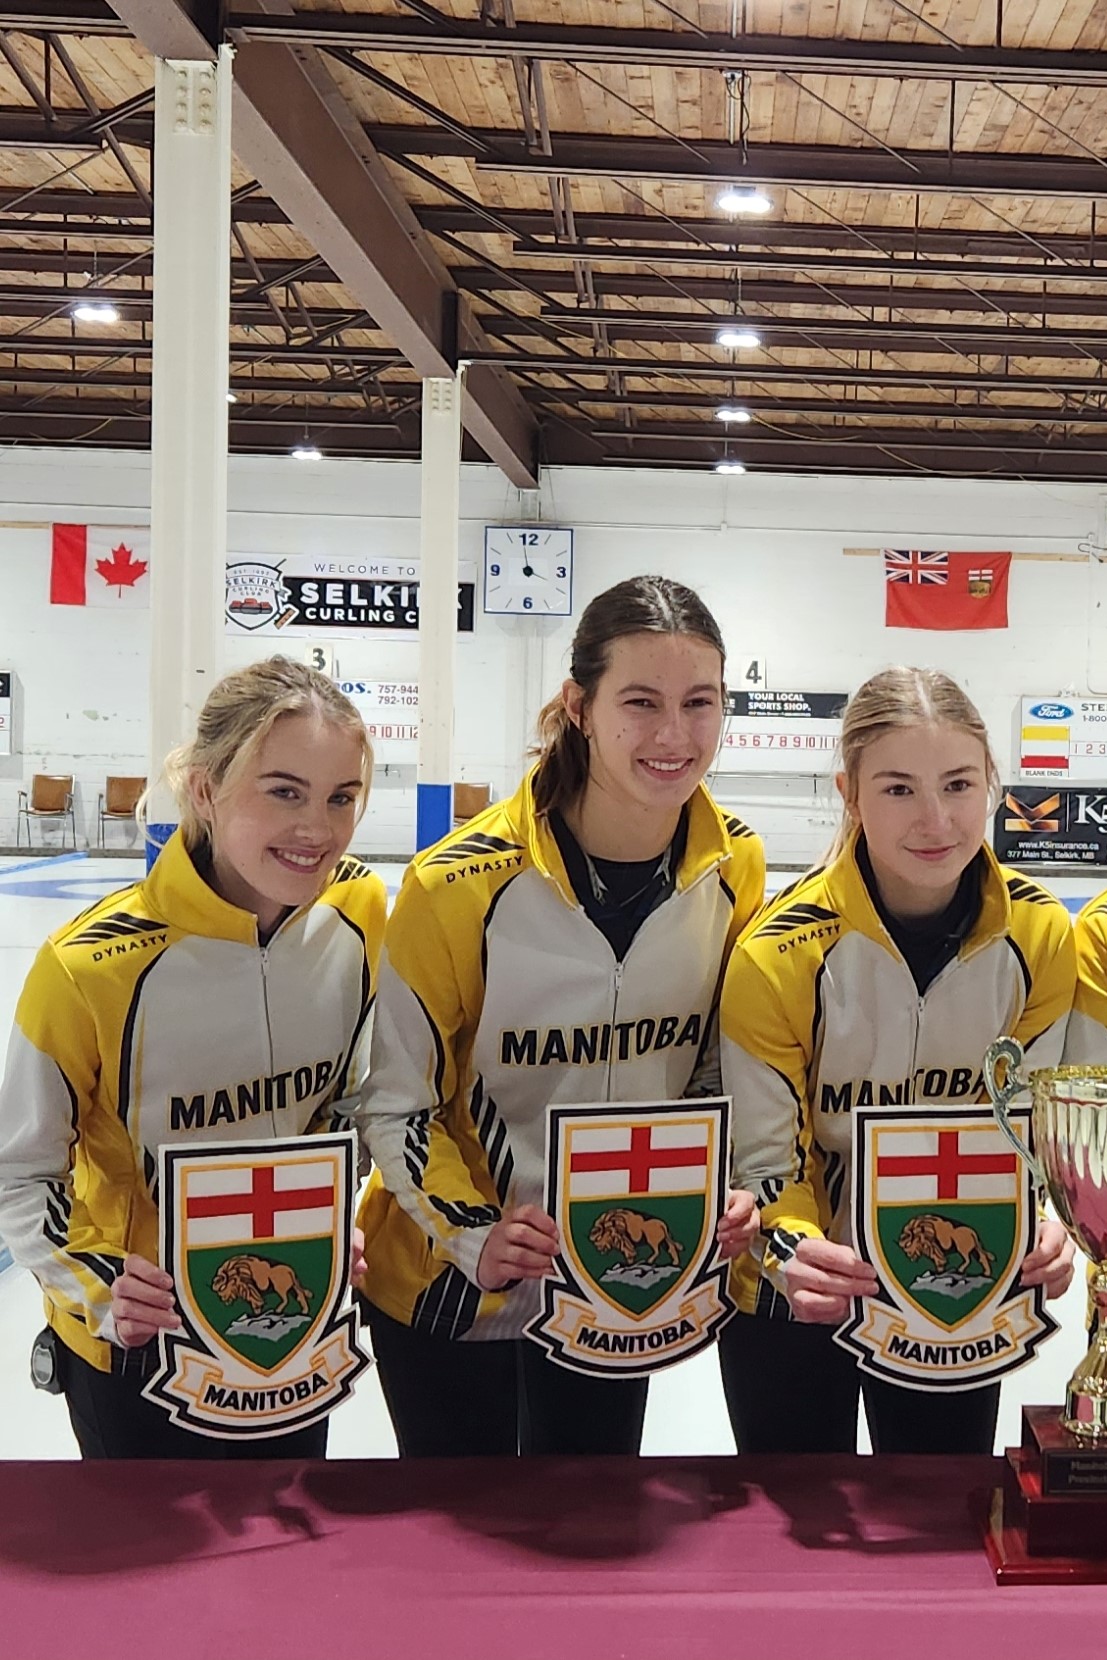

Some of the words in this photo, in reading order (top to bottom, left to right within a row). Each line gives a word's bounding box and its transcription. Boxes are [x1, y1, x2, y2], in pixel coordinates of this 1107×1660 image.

[519, 533, 539, 546] 12
[314, 563, 389, 575] WELCOME
[398, 566, 416, 576] TO
[490, 564, 500, 577] 9
[556, 566, 567, 578] 3
[226, 577, 276, 589] SELKIRK
[300, 582, 463, 610] SELKI
[523, 597, 533, 609] 6
[305, 607, 395, 622] CURLING
[312, 647, 326, 671] 3
[745, 660, 762, 684] 4
[378, 684, 419, 694] 757-944
[378, 696, 419, 705] 792-102
[748, 692, 774, 701] YOUR
[776, 693, 805, 702] LOCAL
[748, 702, 782, 711] SPORTS
[783, 702, 812, 712] SHOP.
[1036, 704, 1065, 719] Ford
[369, 726, 376, 736] 9
[381, 726, 392, 738] 10
[396, 726, 405, 738] 11
[726, 735, 733, 746] 4
[739, 735, 747, 746] 5
[752, 735, 761, 747] 6
[767, 735, 774, 747] 7
[779, 736, 788, 748] 8
[793, 736, 801, 748] 9
[806, 736, 816, 748] 10
[820, 737, 828, 749] 11
[1086, 744, 1093, 754] 2
[1099, 744, 1106, 754] 3
[1022, 850, 1040, 858] Main
[445, 855, 524, 884] DYNASTY
[777, 923, 841, 954] DYNASTY
[92, 934, 168, 963] DYNASTY
[501, 1013, 703, 1066] MANITOBA
[170, 1052, 343, 1131] MANITOB
[576, 1319, 697, 1353] MANITOBA
[888, 1332, 1012, 1365] MANITOBA
[203, 1372, 329, 1412] MANITOBA
